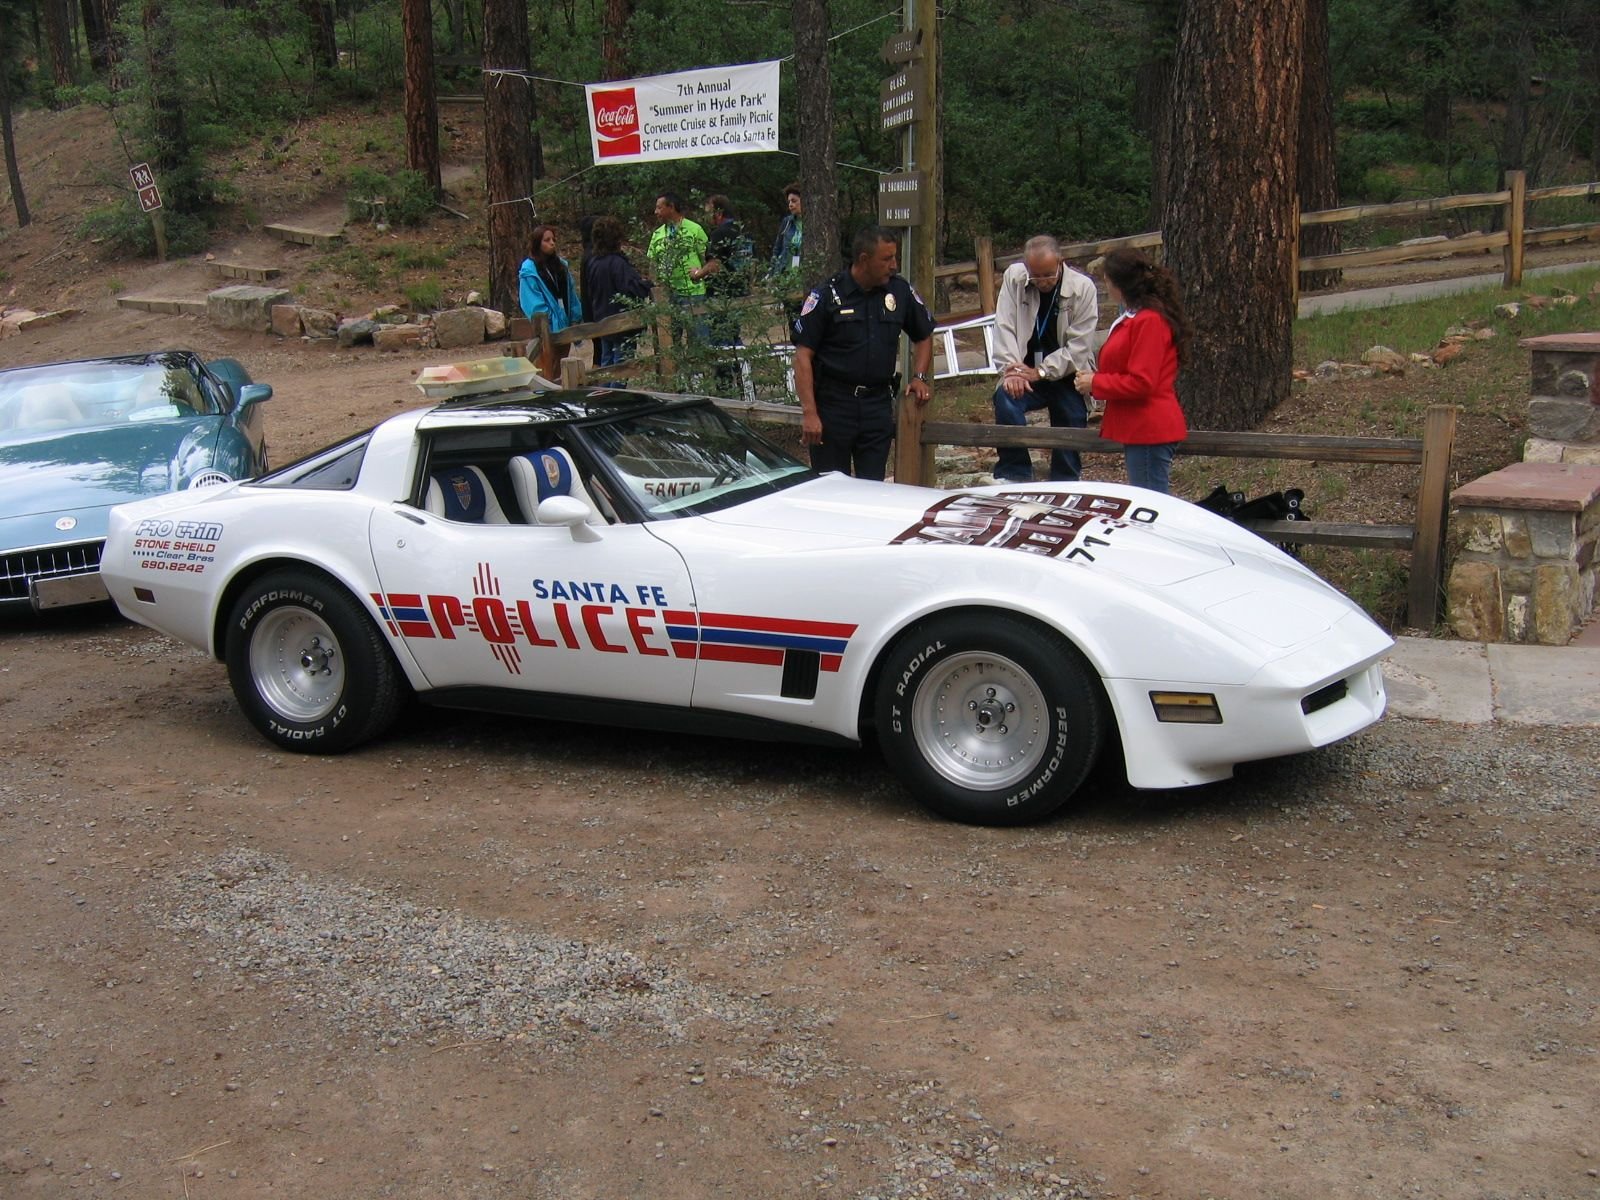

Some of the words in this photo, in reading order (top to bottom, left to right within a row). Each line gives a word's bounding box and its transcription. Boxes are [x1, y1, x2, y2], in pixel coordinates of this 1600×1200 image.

[677, 84, 694, 97] 7th
[697, 78, 731, 95] Annual
[889, 74, 906, 91] GLASS
[697, 99, 707, 112] in
[710, 96, 737, 112] Hyde
[882, 90, 914, 113] CONTAINERS
[644, 121, 678, 135] Corvette
[680, 117, 706, 132] Cruise
[709, 116, 717, 127] &
[720, 112, 747, 128] Family
[749, 110, 773, 125] Picnic
[883, 108, 913, 129] PROHIBITED
[642, 139, 650, 152] SF
[653, 136, 688, 151] Chevrolet
[690, 136, 698, 147] &
[700, 131, 741, 147] Coca-Cola
[743, 130, 765, 142] Santa
[767, 128, 776, 141] Fe
[644, 482, 701, 497] SANTA
[136, 519, 175, 538] PRO
[135, 539, 171, 550] STONE
[173, 541, 216, 553] SHEILD
[156, 550, 184, 560] Clear
[187, 552, 214, 563] Bras
[141, 560, 205, 573] 690.8242
[532, 578, 630, 605] SANTA
[636, 584, 668, 607] FE
[239, 589, 324, 630] PERFORMER
[427, 594, 669, 657] POLICE
[896, 640, 947, 696] RADIAL
[332, 704, 347, 728] GT
[892, 705, 902, 733] GT
[268, 719, 325, 740] RADIAL
[1006, 706, 1068, 807] PERFORMER
